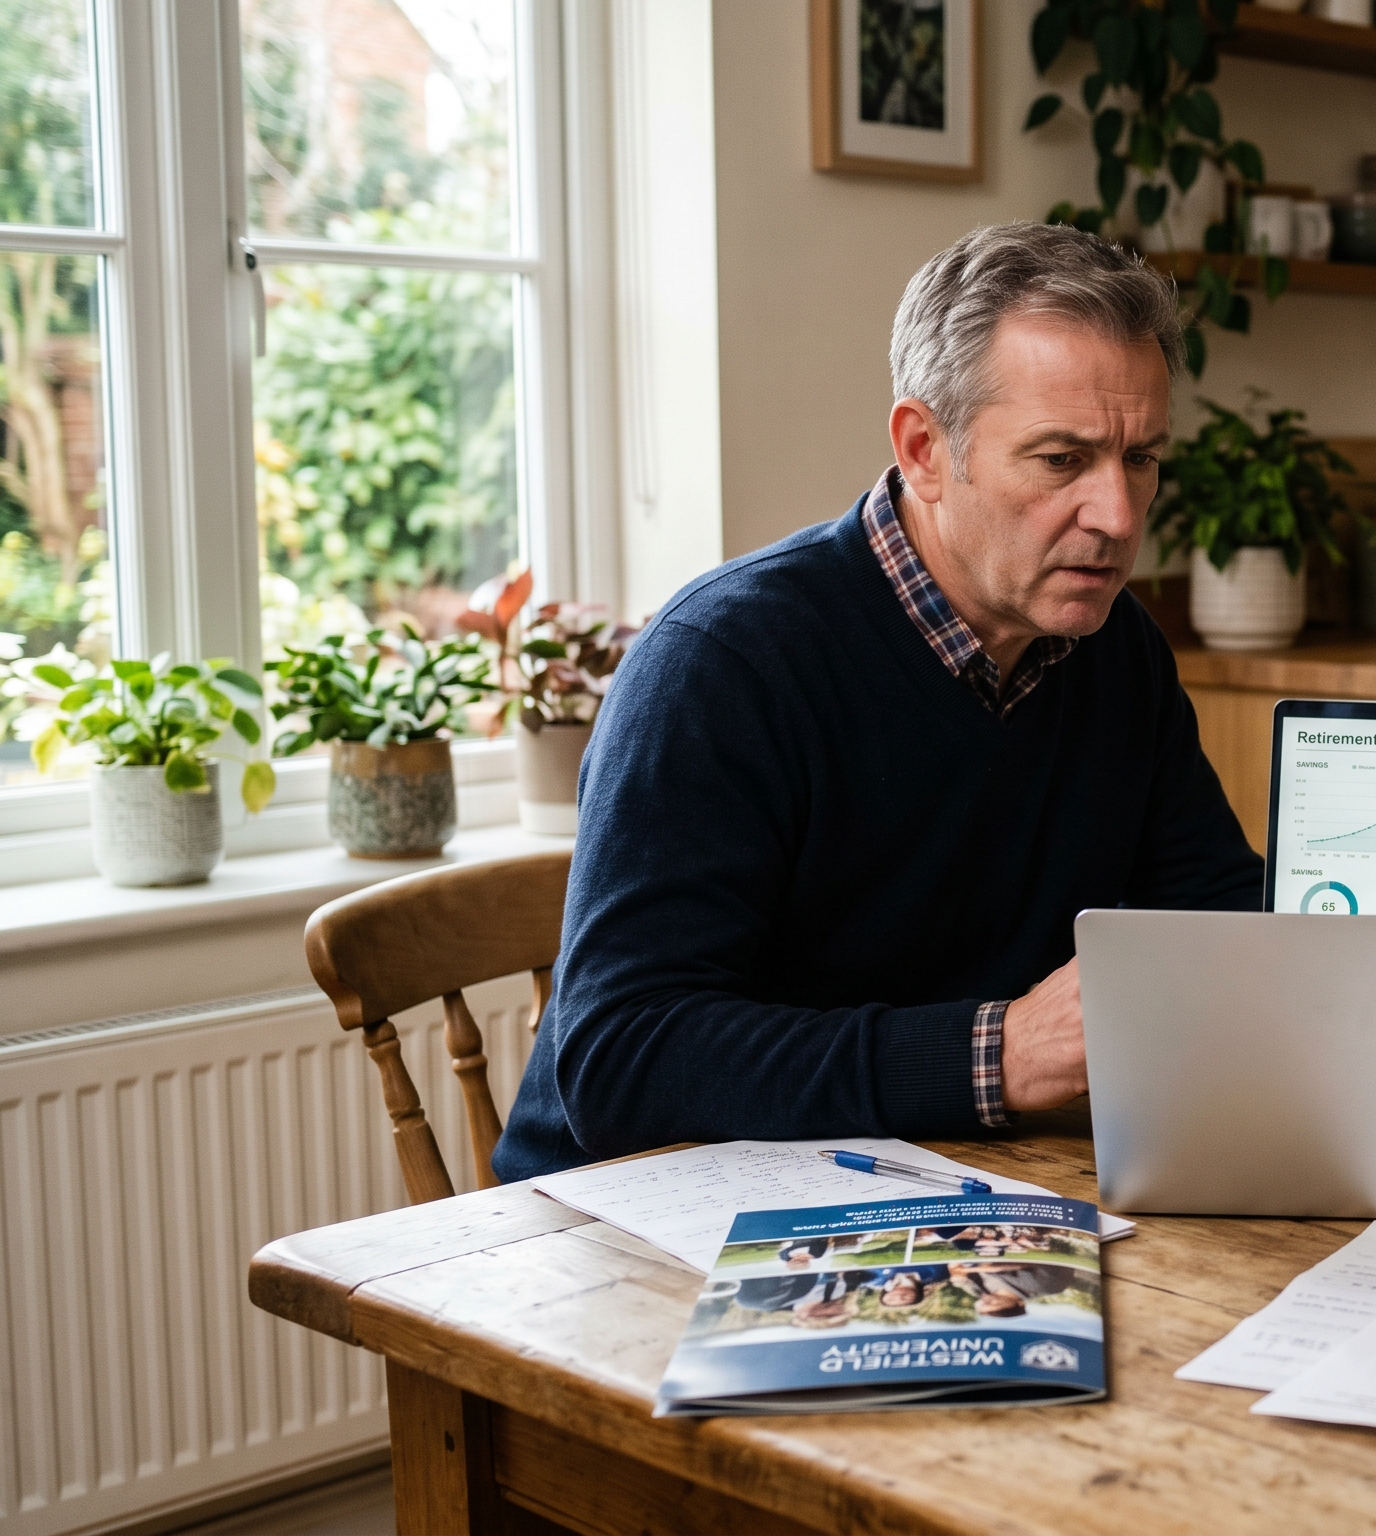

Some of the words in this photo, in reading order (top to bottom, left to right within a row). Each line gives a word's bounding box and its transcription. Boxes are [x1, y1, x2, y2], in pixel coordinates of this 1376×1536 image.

[1296, 761, 1329, 769] SAVINGS
[1321, 902, 1336, 911] 65
[821, 1337, 1005, 1359] UNIVERSITY
[819, 1351, 1004, 1373] WESTFIELD
